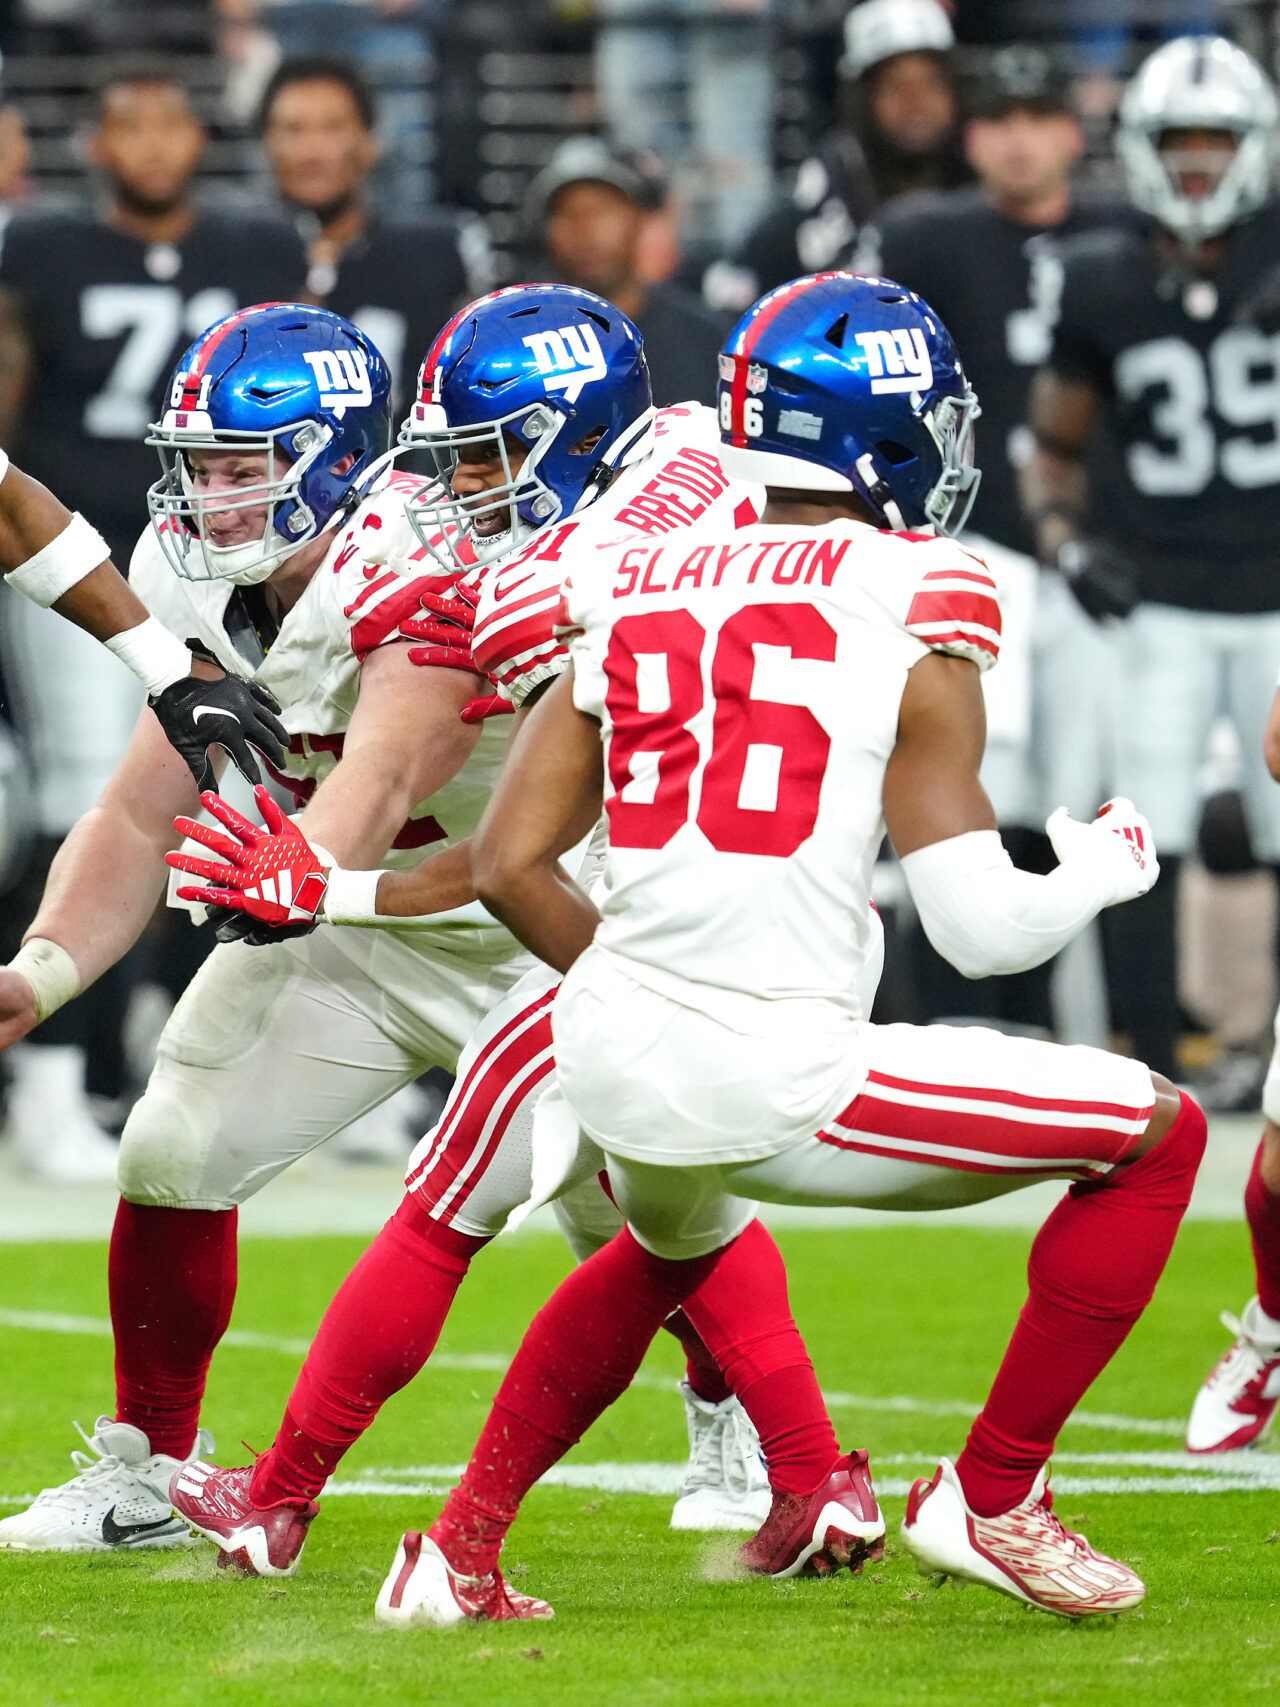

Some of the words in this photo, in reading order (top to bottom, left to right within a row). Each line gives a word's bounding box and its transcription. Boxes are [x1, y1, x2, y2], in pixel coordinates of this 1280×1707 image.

[79, 281, 237, 439] 7
[170, 371, 213, 410] 61
[302, 349, 373, 421] ny
[521, 323, 608, 405] ny
[854, 328, 934, 395] ny
[720, 390, 764, 438] 86
[612, 538, 853, 600] SLAYTON
[602, 602, 838, 858] 86
